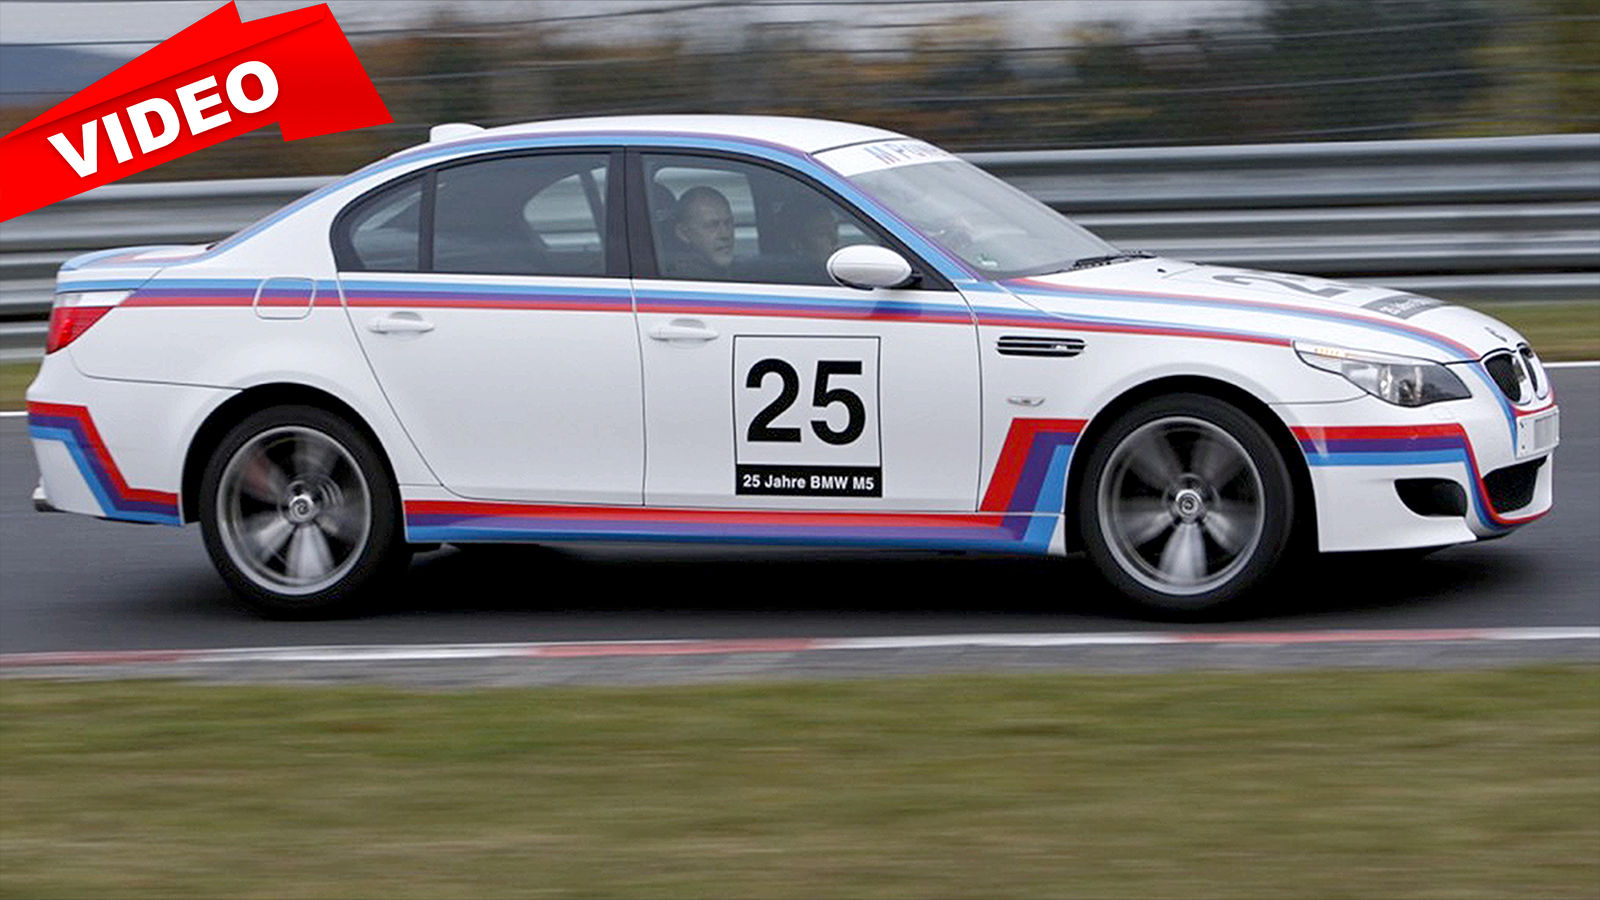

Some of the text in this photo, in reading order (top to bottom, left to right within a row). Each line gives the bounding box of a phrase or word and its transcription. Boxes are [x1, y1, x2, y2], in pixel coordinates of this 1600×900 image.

[746, 358, 866, 445] 25
[743, 474, 875, 490] 25 Jahre BMW M5
